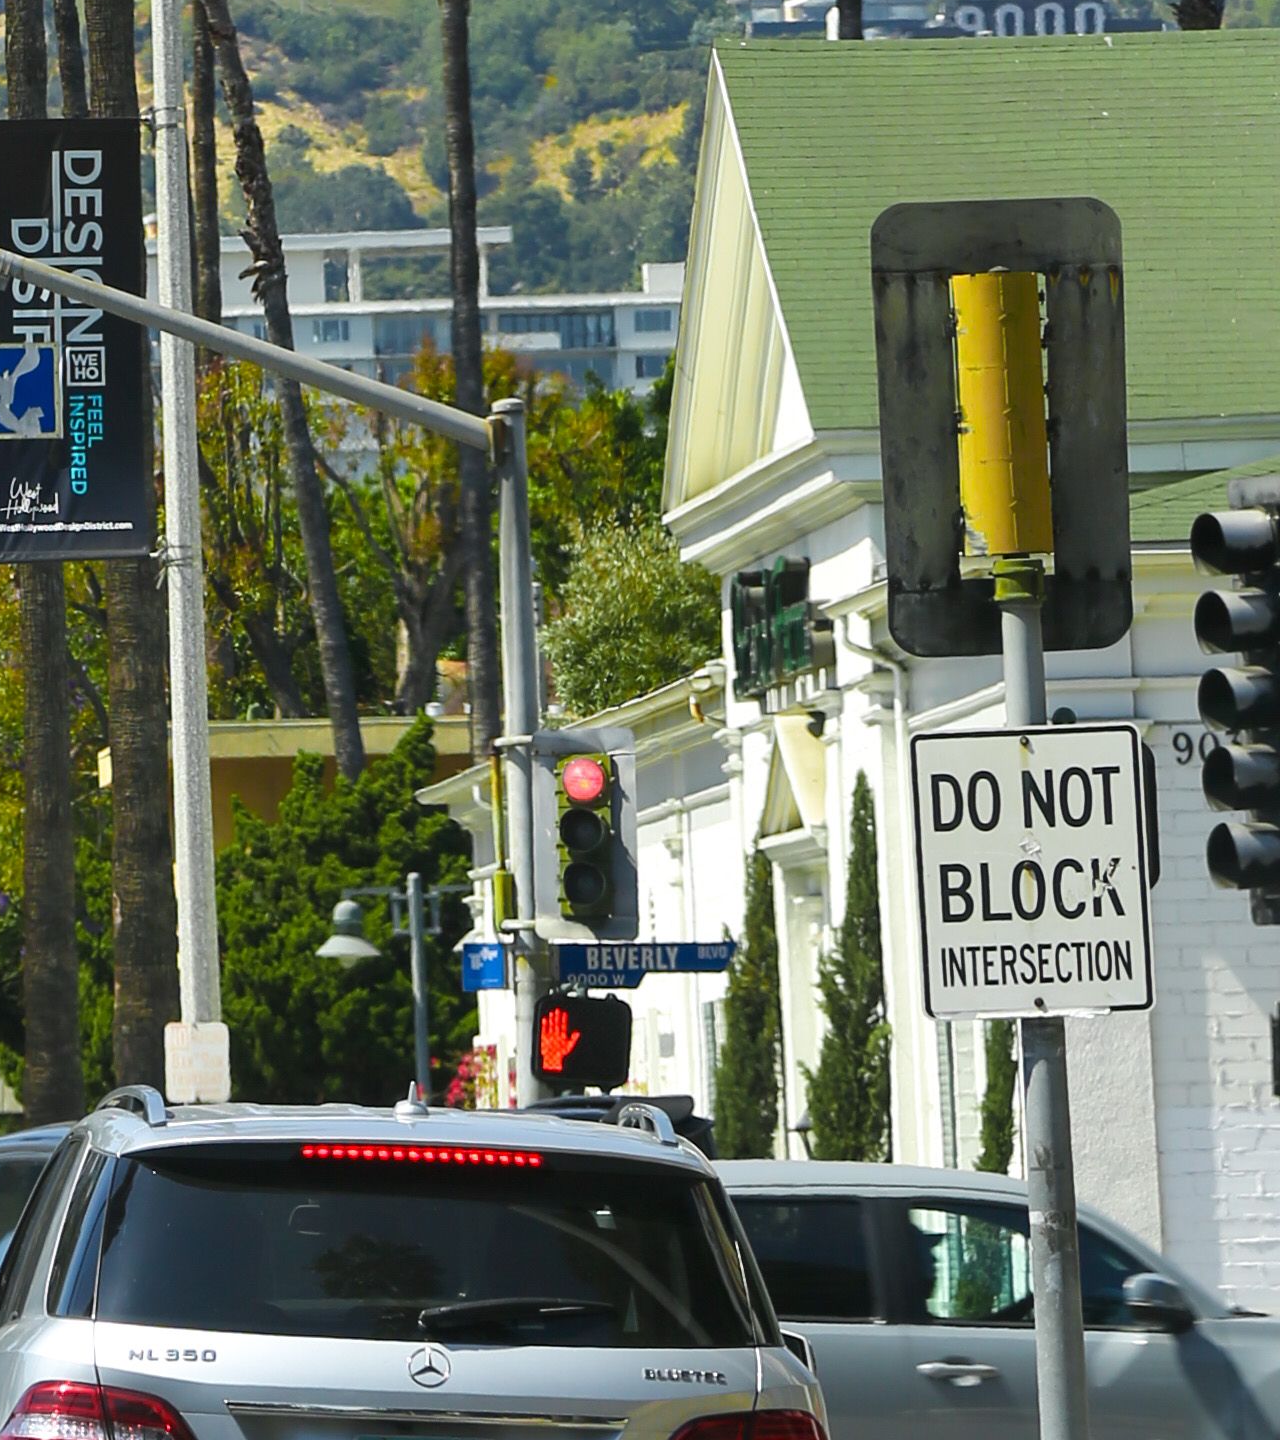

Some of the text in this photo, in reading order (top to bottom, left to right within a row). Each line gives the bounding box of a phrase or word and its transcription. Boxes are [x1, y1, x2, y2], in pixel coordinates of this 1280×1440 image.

[954, 2, 1105, 36] 9000
[71, 352, 98, 366] WE
[74, 365, 99, 380] HO
[88, 395, 103, 448] FEEL
[69, 395, 88, 496] INSPIRED
[9, 477, 43, 504] West
[0, 492, 60, 521] Hollywood
[930, 766, 1121, 833] DO NOT
[939, 857, 1126, 923] BLOCK
[586, 944, 729, 970] BEVERLY BLVD
[940, 940, 1133, 988] INTERSECTION
[567, 973, 626, 987] 9000 W
[164, 1349, 218, 1363] 350
[642, 1368, 728, 1386] BLUETEC
